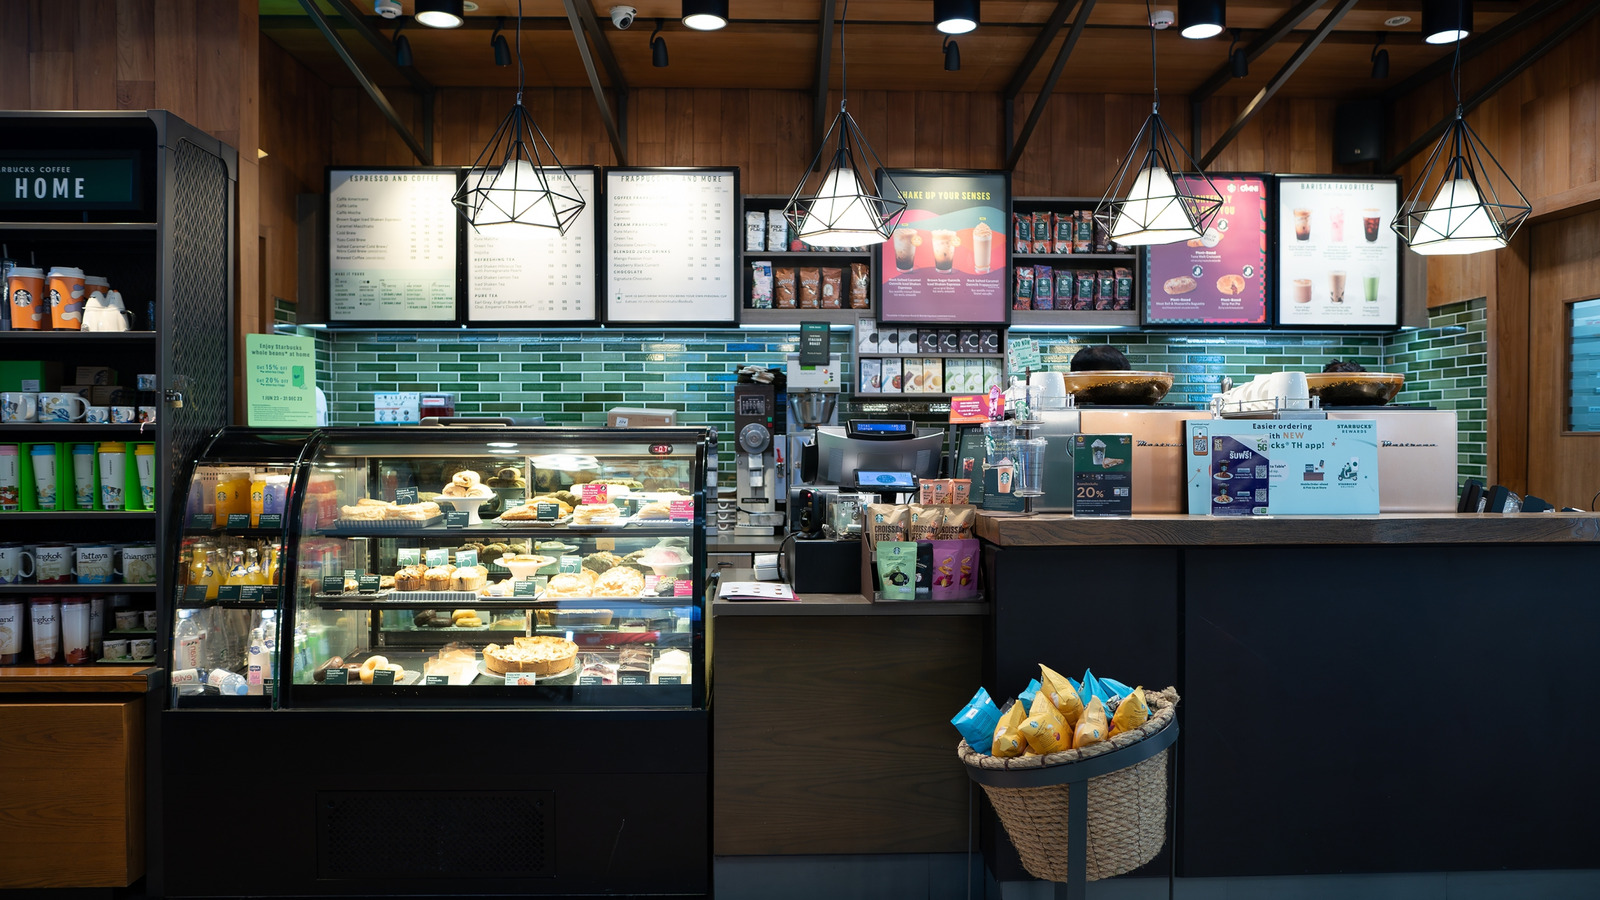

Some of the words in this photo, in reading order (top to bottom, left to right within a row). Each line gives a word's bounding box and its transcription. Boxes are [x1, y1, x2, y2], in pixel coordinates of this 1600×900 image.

[15, 178, 85, 198] HOME
[962, 192, 991, 200] SENSES
[1220, 206, 1235, 215] YOU
[1305, 442, 1324, 450] app!
[1077, 487, 1104, 498] 20%
[36, 552, 62, 562] angkok
[81, 553, 107, 561] Pattaya
